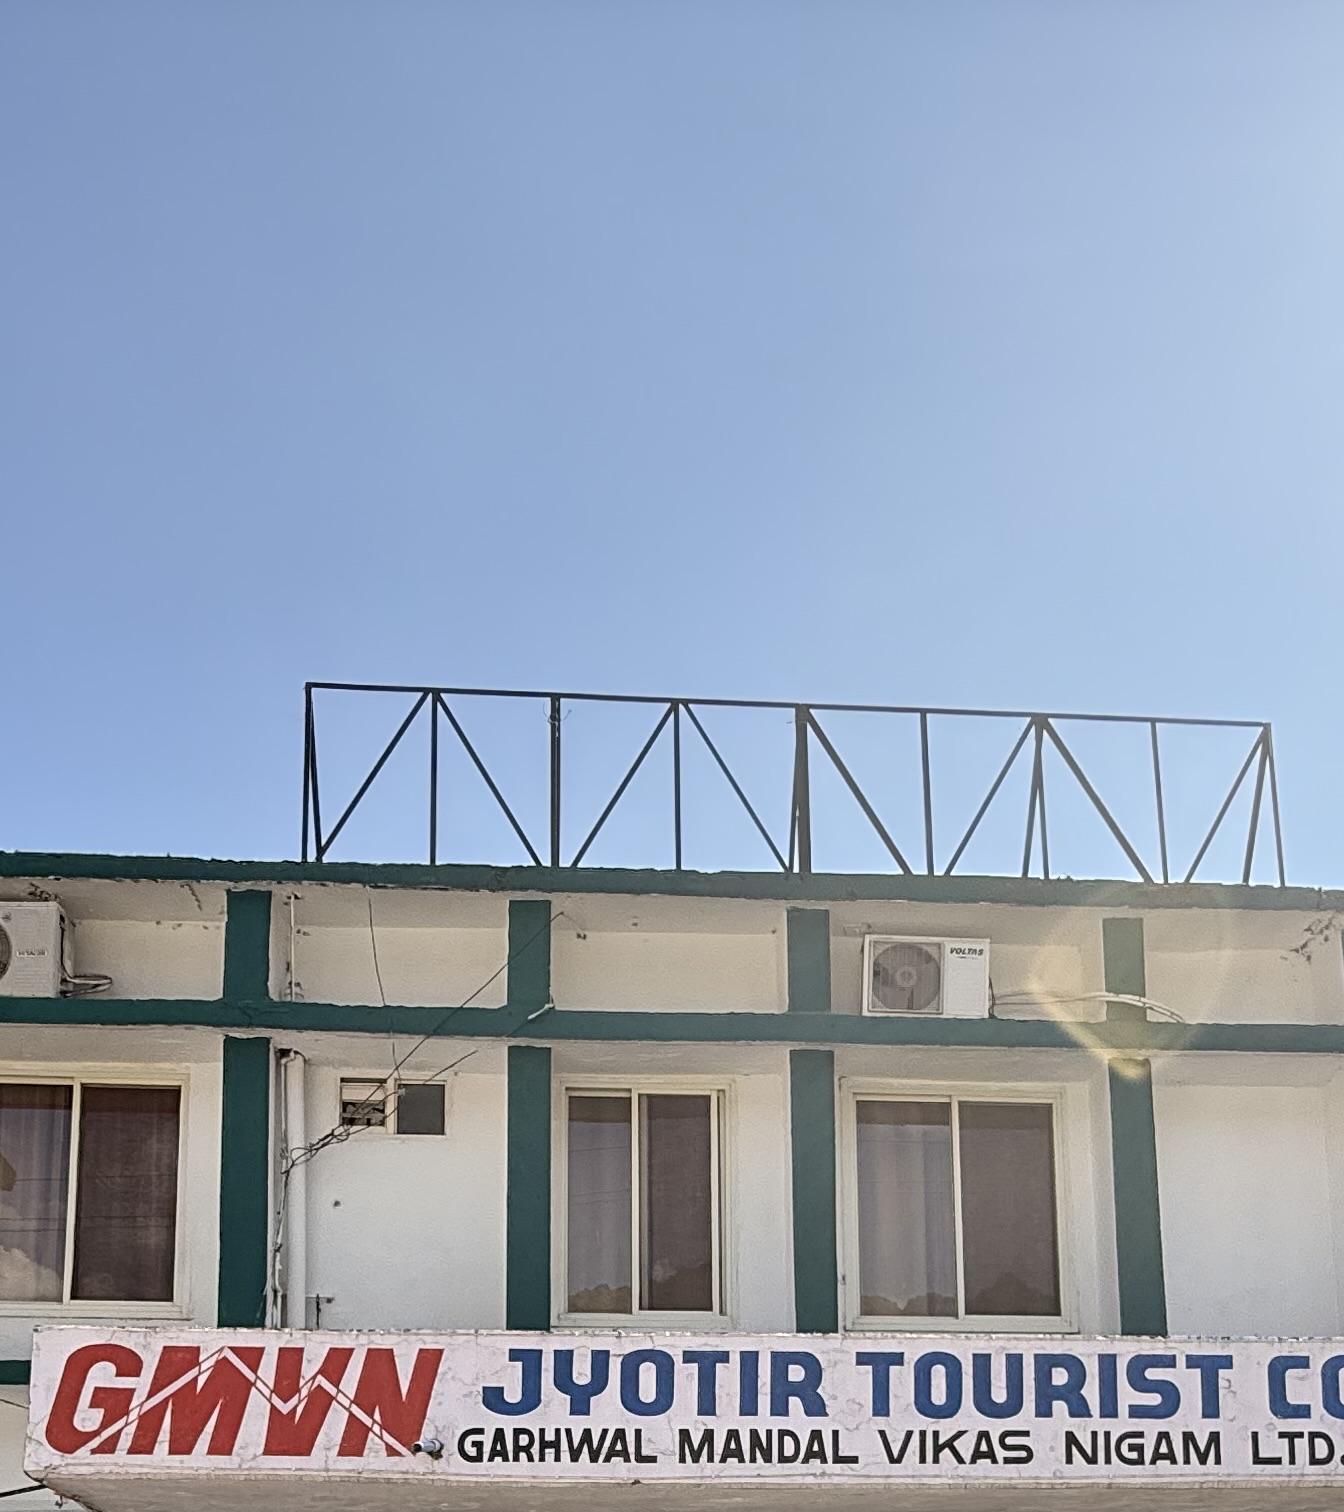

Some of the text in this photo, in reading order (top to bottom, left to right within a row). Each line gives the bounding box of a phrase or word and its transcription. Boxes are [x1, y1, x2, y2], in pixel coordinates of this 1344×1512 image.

[949, 947, 985, 956] VOLTAS
[45, 1343, 444, 1457] GMVN
[482, 1348, 826, 1417] JYOTIR
[858, 1352, 1233, 1419] TOURIST
[457, 1427, 658, 1464] GARHWAL
[678, 1428, 859, 1465] MANDAL
[877, 1429, 1034, 1465] VIKAS
[1065, 1430, 1222, 1466] NIGAM
